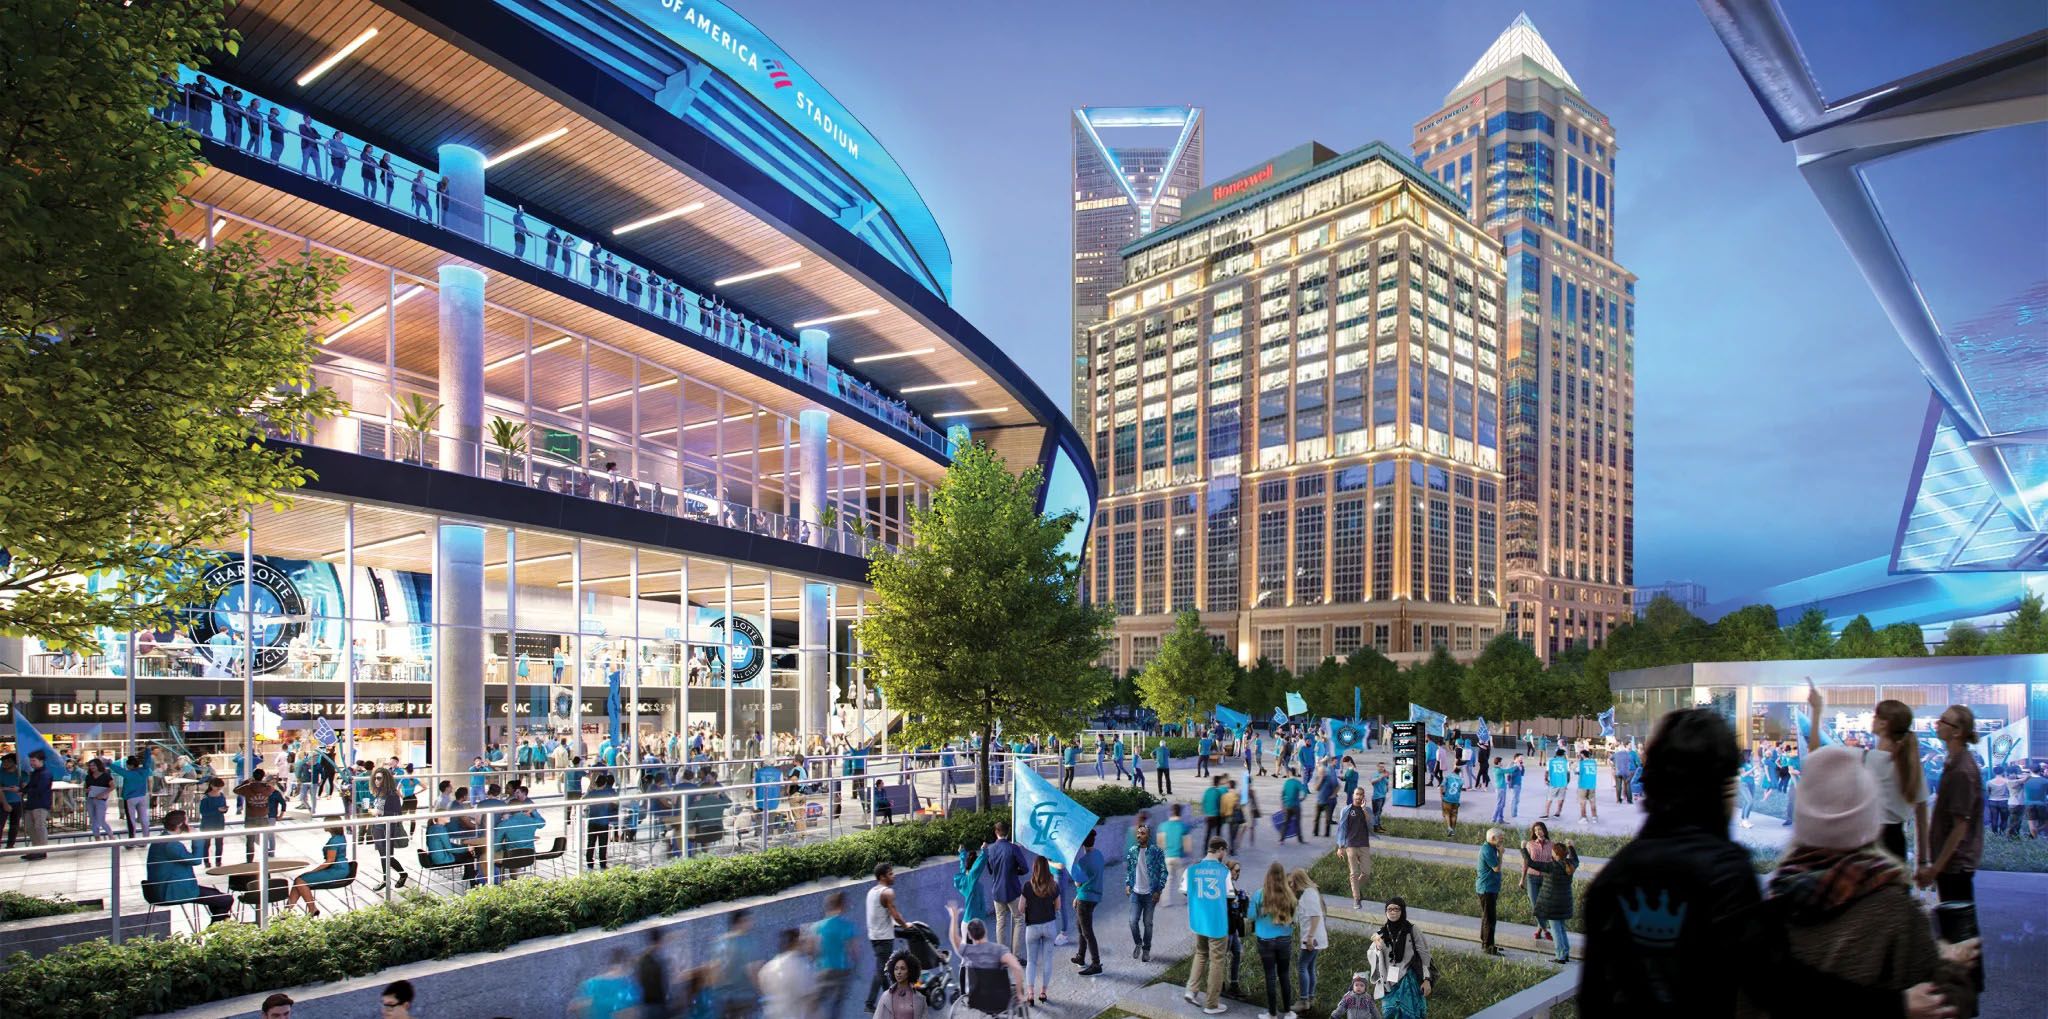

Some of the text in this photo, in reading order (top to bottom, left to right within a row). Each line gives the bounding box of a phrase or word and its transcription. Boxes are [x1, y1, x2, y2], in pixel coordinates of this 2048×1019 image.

[684, 7, 759, 72] AMERICA
[796, 91, 859, 160] STADIUM
[1213, 163, 1272, 203] Honeywell
[205, 564, 292, 599] CHAROTTE
[625, 703, 650, 713] GAC
[1448, 781, 1459, 795] 8
[1194, 877, 1221, 899] 13
